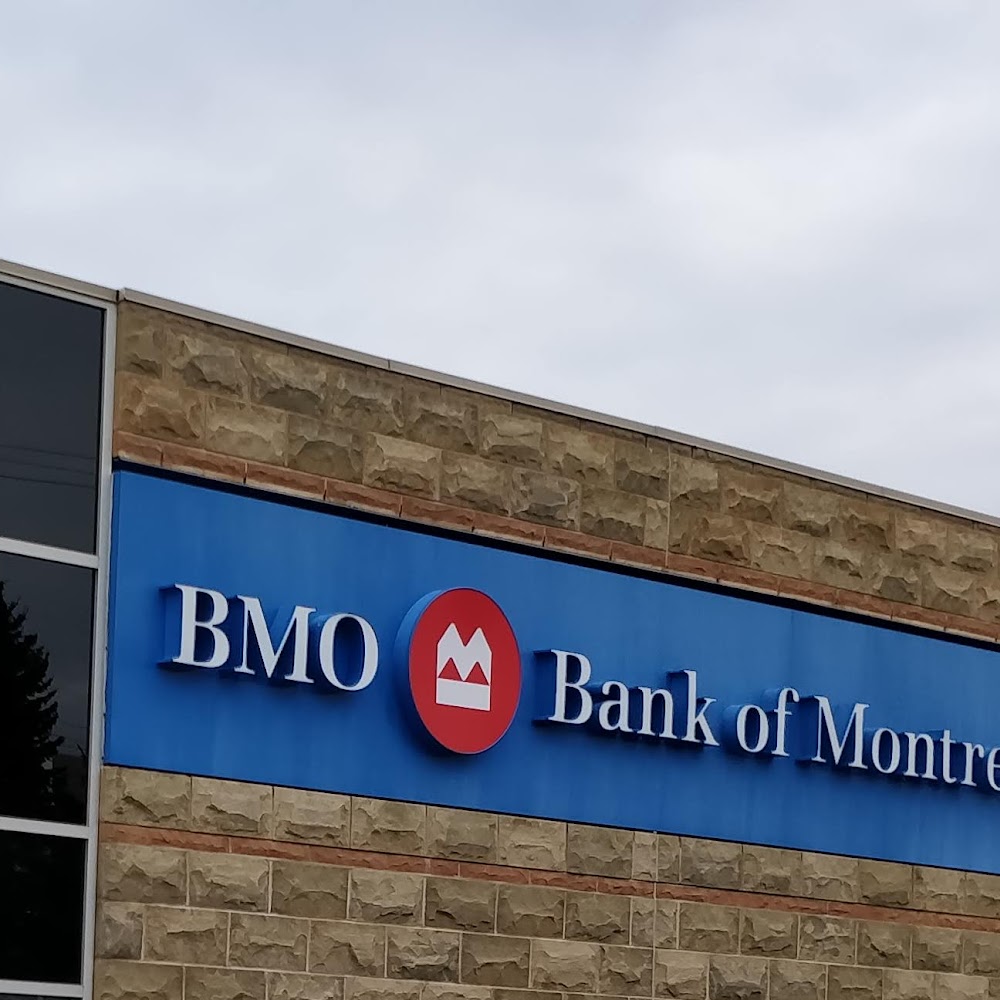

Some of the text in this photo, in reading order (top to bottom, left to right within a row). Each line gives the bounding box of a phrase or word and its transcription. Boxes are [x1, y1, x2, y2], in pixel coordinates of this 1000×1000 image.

[173, 584, 379, 691] BMO
[548, 649, 720, 746] Bank
[737, 687, 799, 757] of
